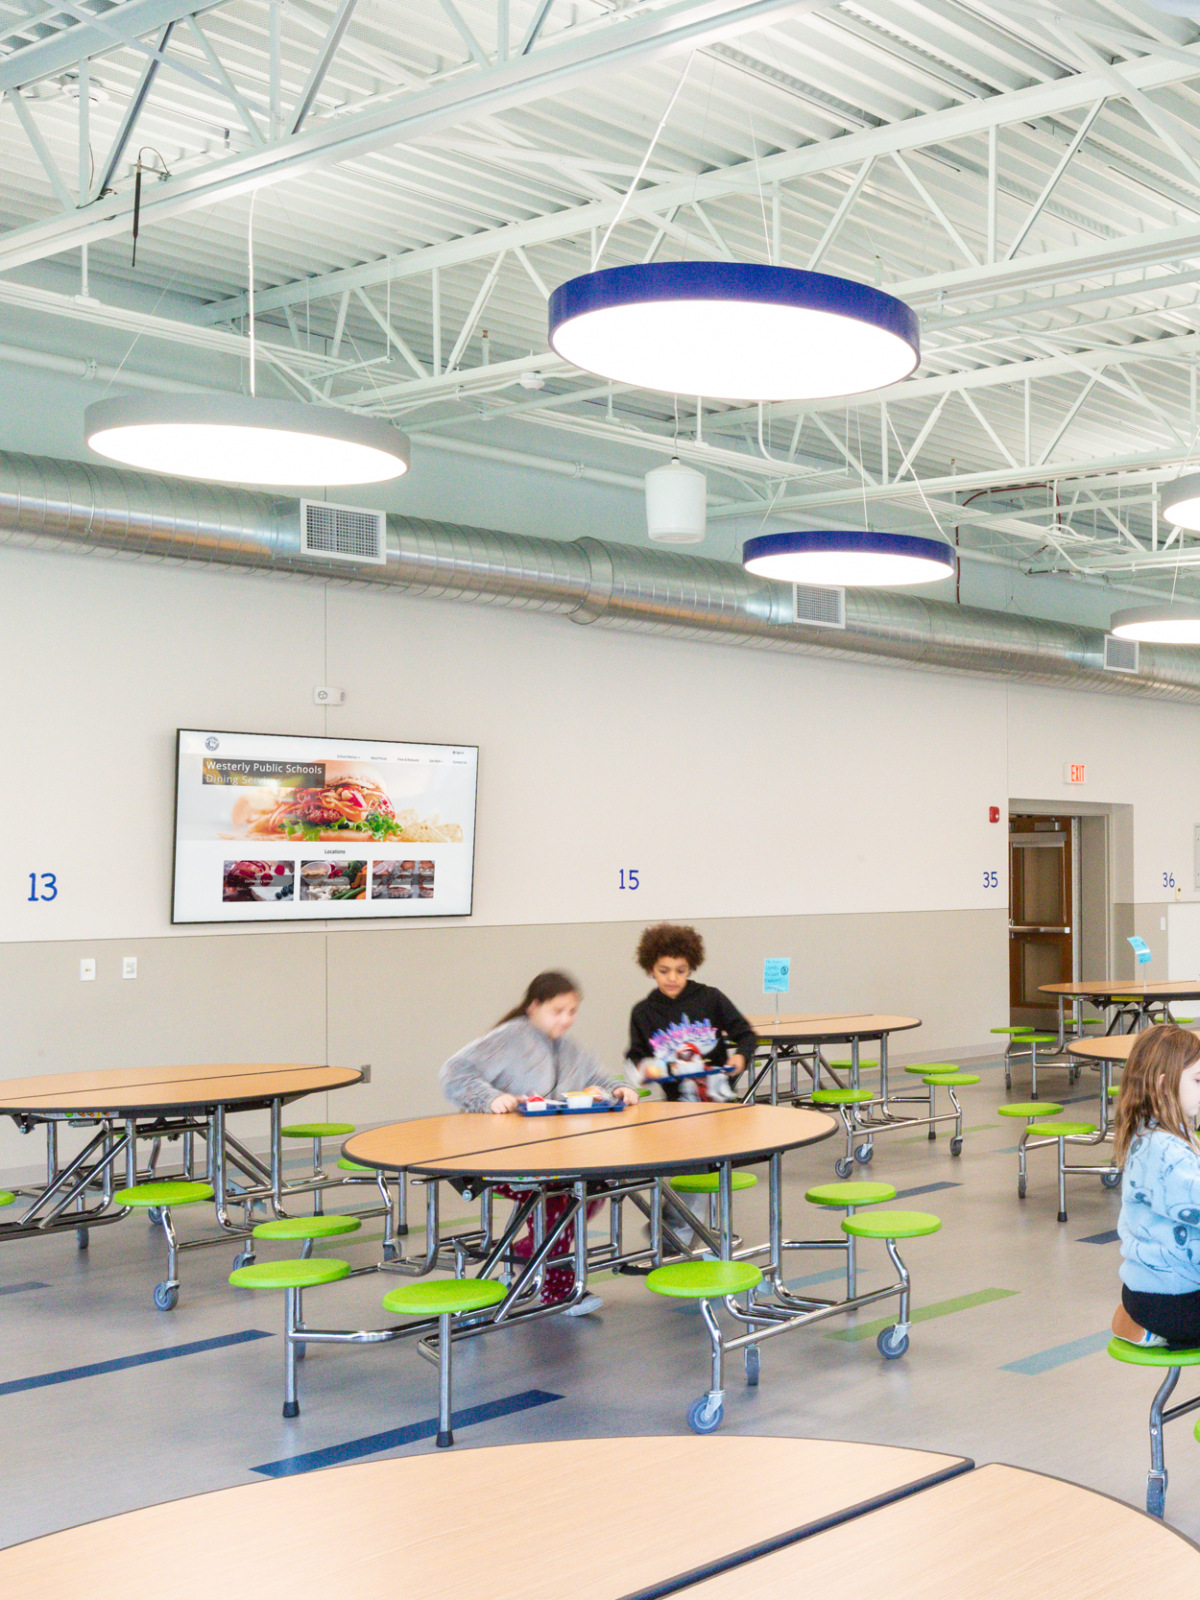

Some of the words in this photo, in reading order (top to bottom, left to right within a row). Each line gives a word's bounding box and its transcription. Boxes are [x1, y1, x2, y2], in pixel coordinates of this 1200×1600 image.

[206, 761, 251, 773] Westerly
[253, 763, 283, 773] Public
[286, 764, 322, 775] Schools
[1071, 764, 1085, 782] EXIT
[205, 774, 239, 785] Dining
[27, 872, 58, 901] 13
[619, 868, 640, 890] 15
[982, 871, 998, 888] 35
[1162, 872, 1175, 888] 36
